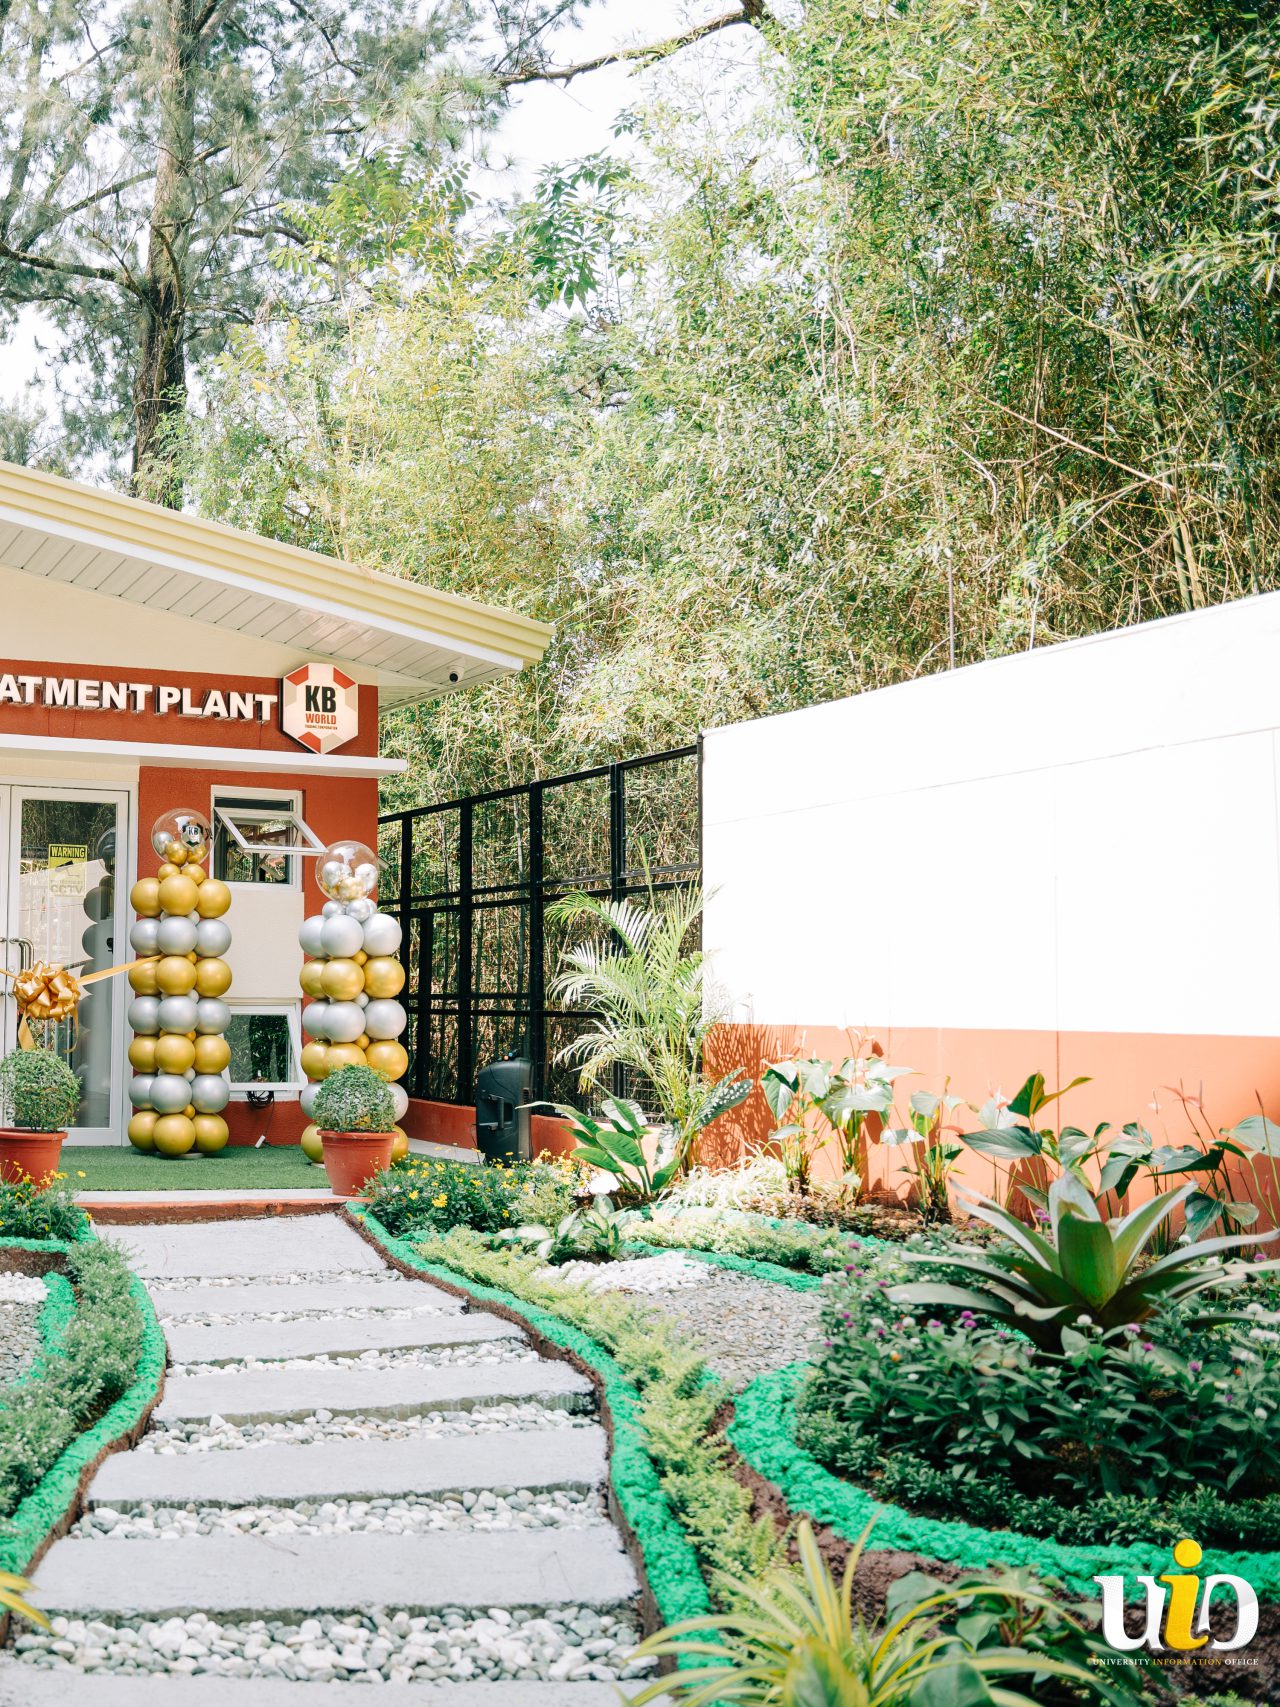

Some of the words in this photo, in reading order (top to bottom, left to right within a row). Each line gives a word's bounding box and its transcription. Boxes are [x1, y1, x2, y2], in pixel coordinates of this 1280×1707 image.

[158, 686, 278, 721] PLANT
[305, 684, 337, 713] KB
[305, 713, 337, 725] WORLD
[51, 846, 85, 858] WARNING
[50, 884, 84, 894] CCTV
